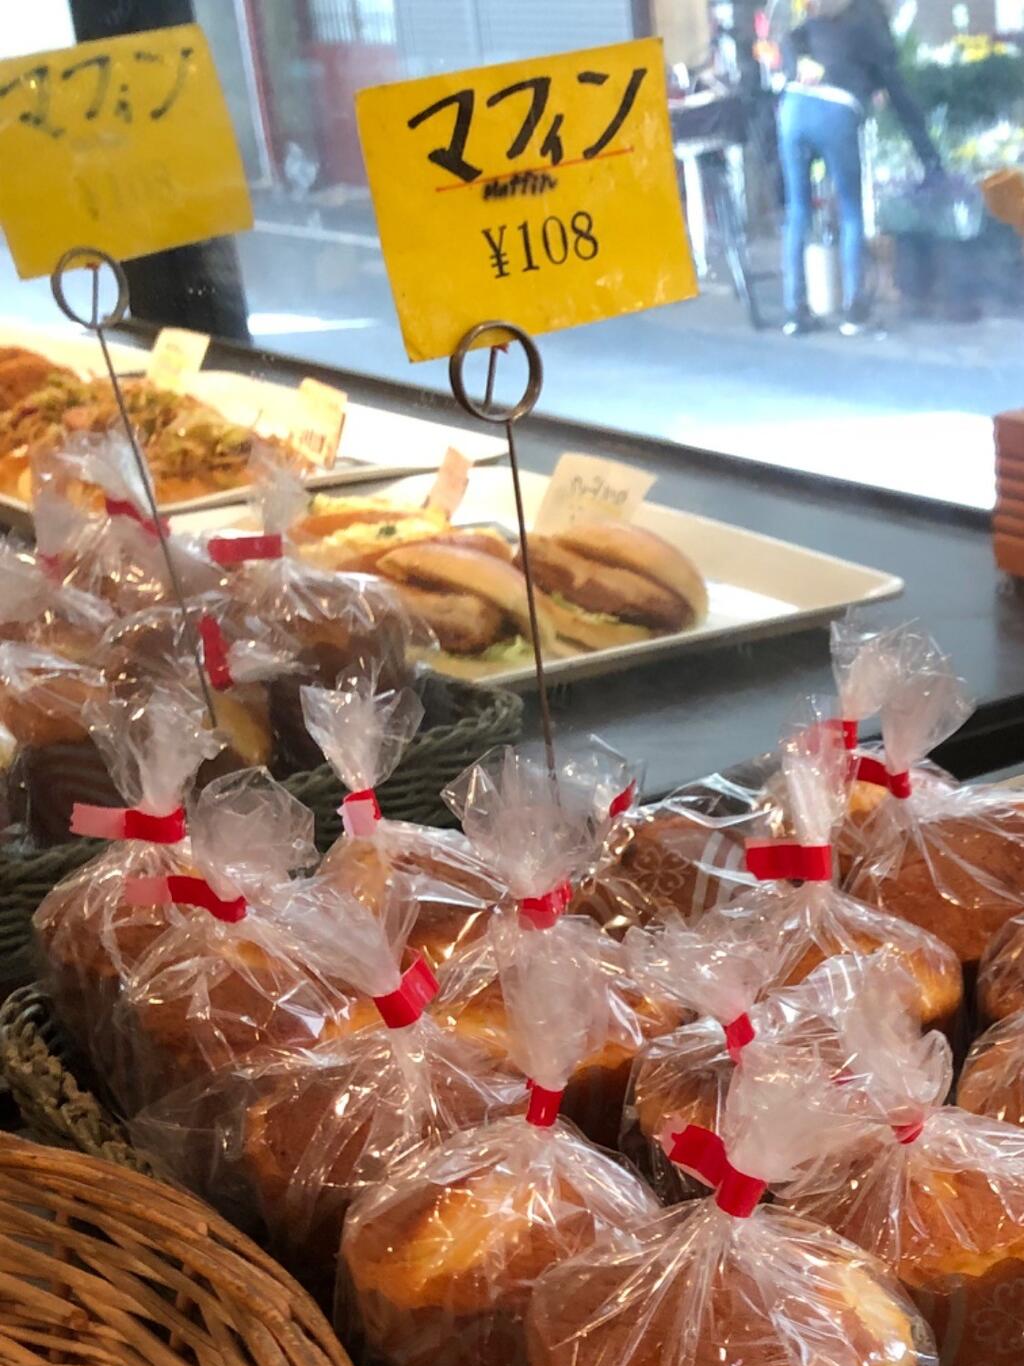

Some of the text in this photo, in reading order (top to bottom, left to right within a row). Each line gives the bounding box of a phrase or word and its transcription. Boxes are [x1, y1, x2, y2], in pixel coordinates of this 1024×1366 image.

[407, 68, 648, 183] マフィン
[481, 211, 599, 279] ¥108
